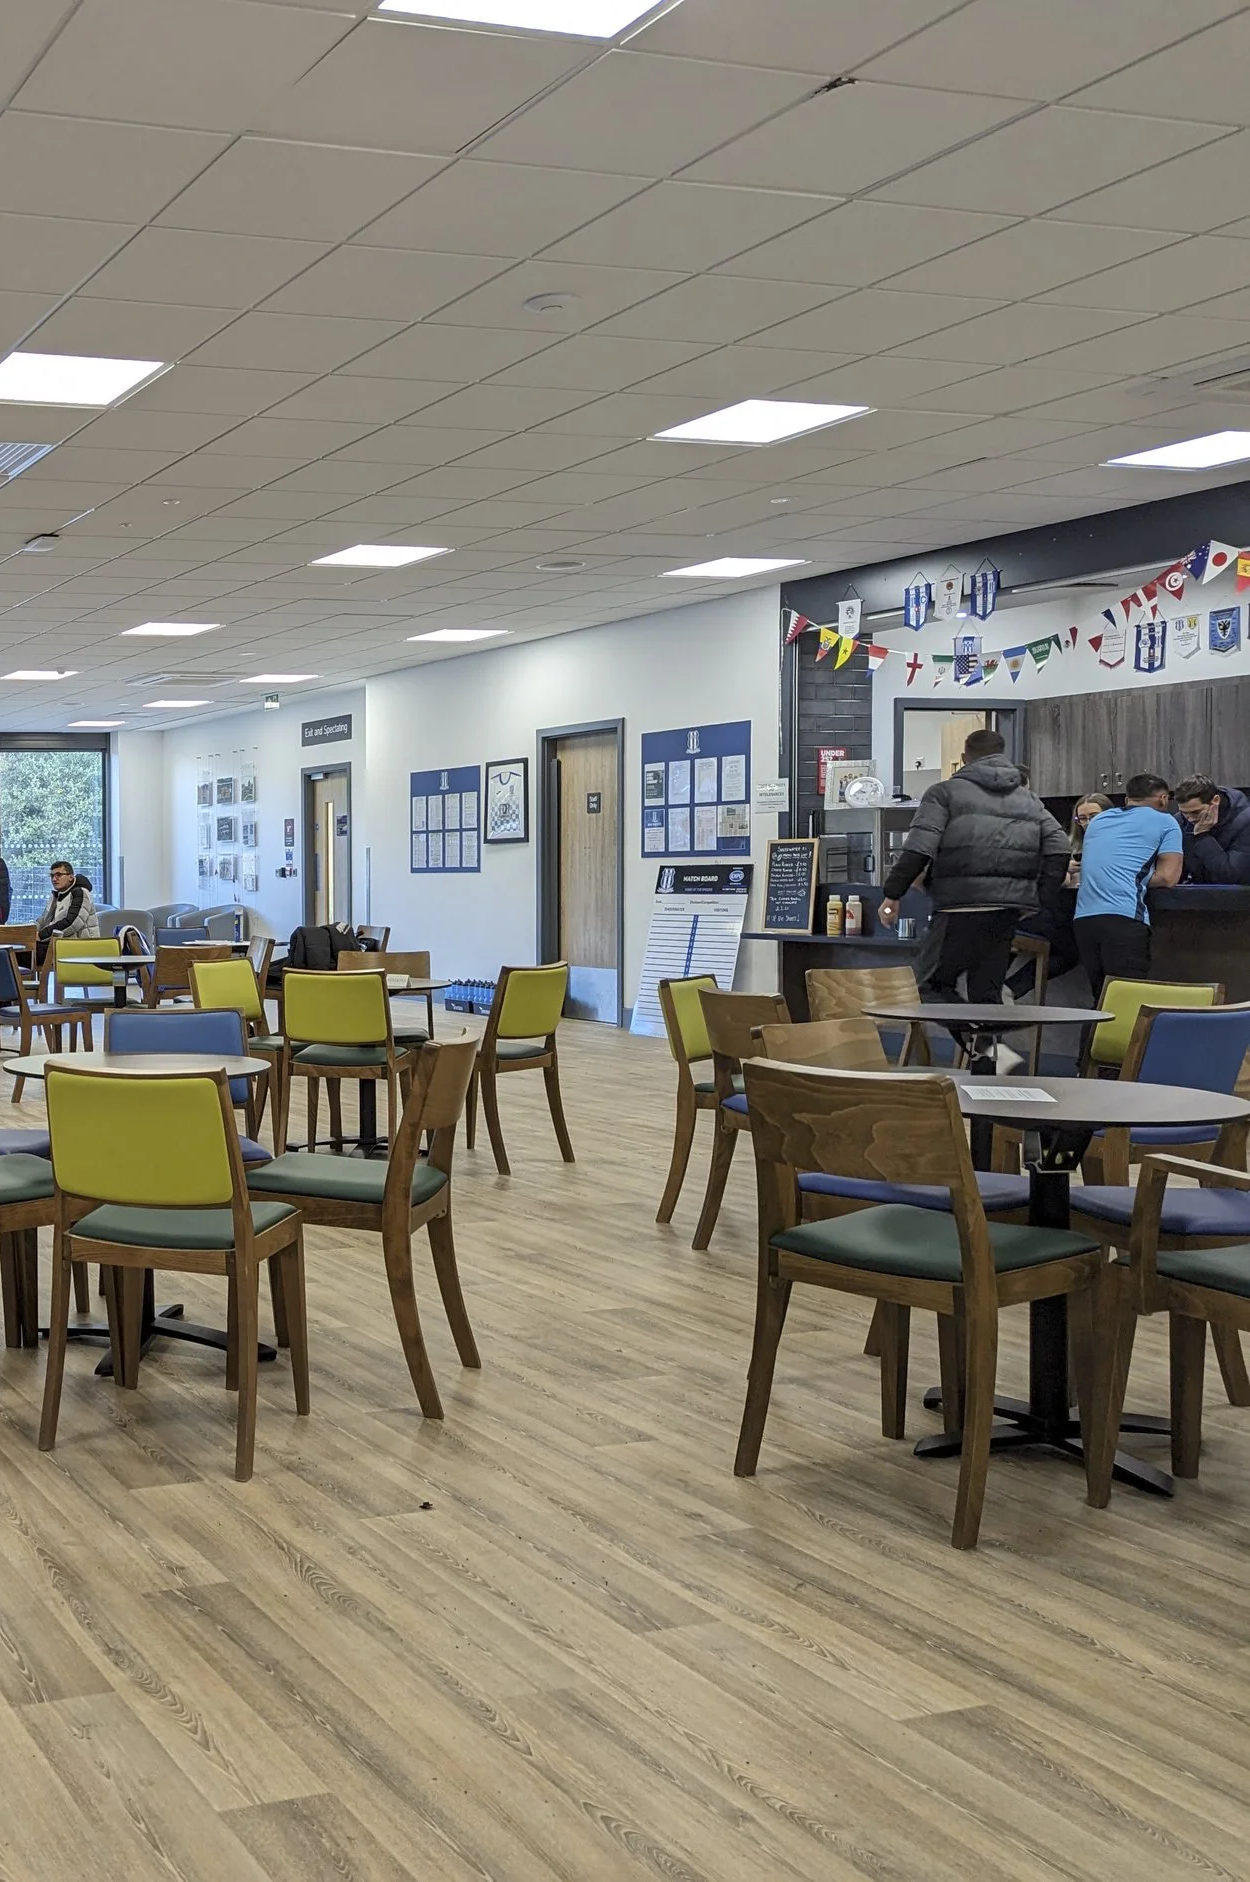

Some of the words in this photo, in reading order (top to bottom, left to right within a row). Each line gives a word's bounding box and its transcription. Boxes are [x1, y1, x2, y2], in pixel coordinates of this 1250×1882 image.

[305, 727, 313, 738] Exit
[314, 726, 323, 736] and
[324, 723, 348, 736] Spectating
